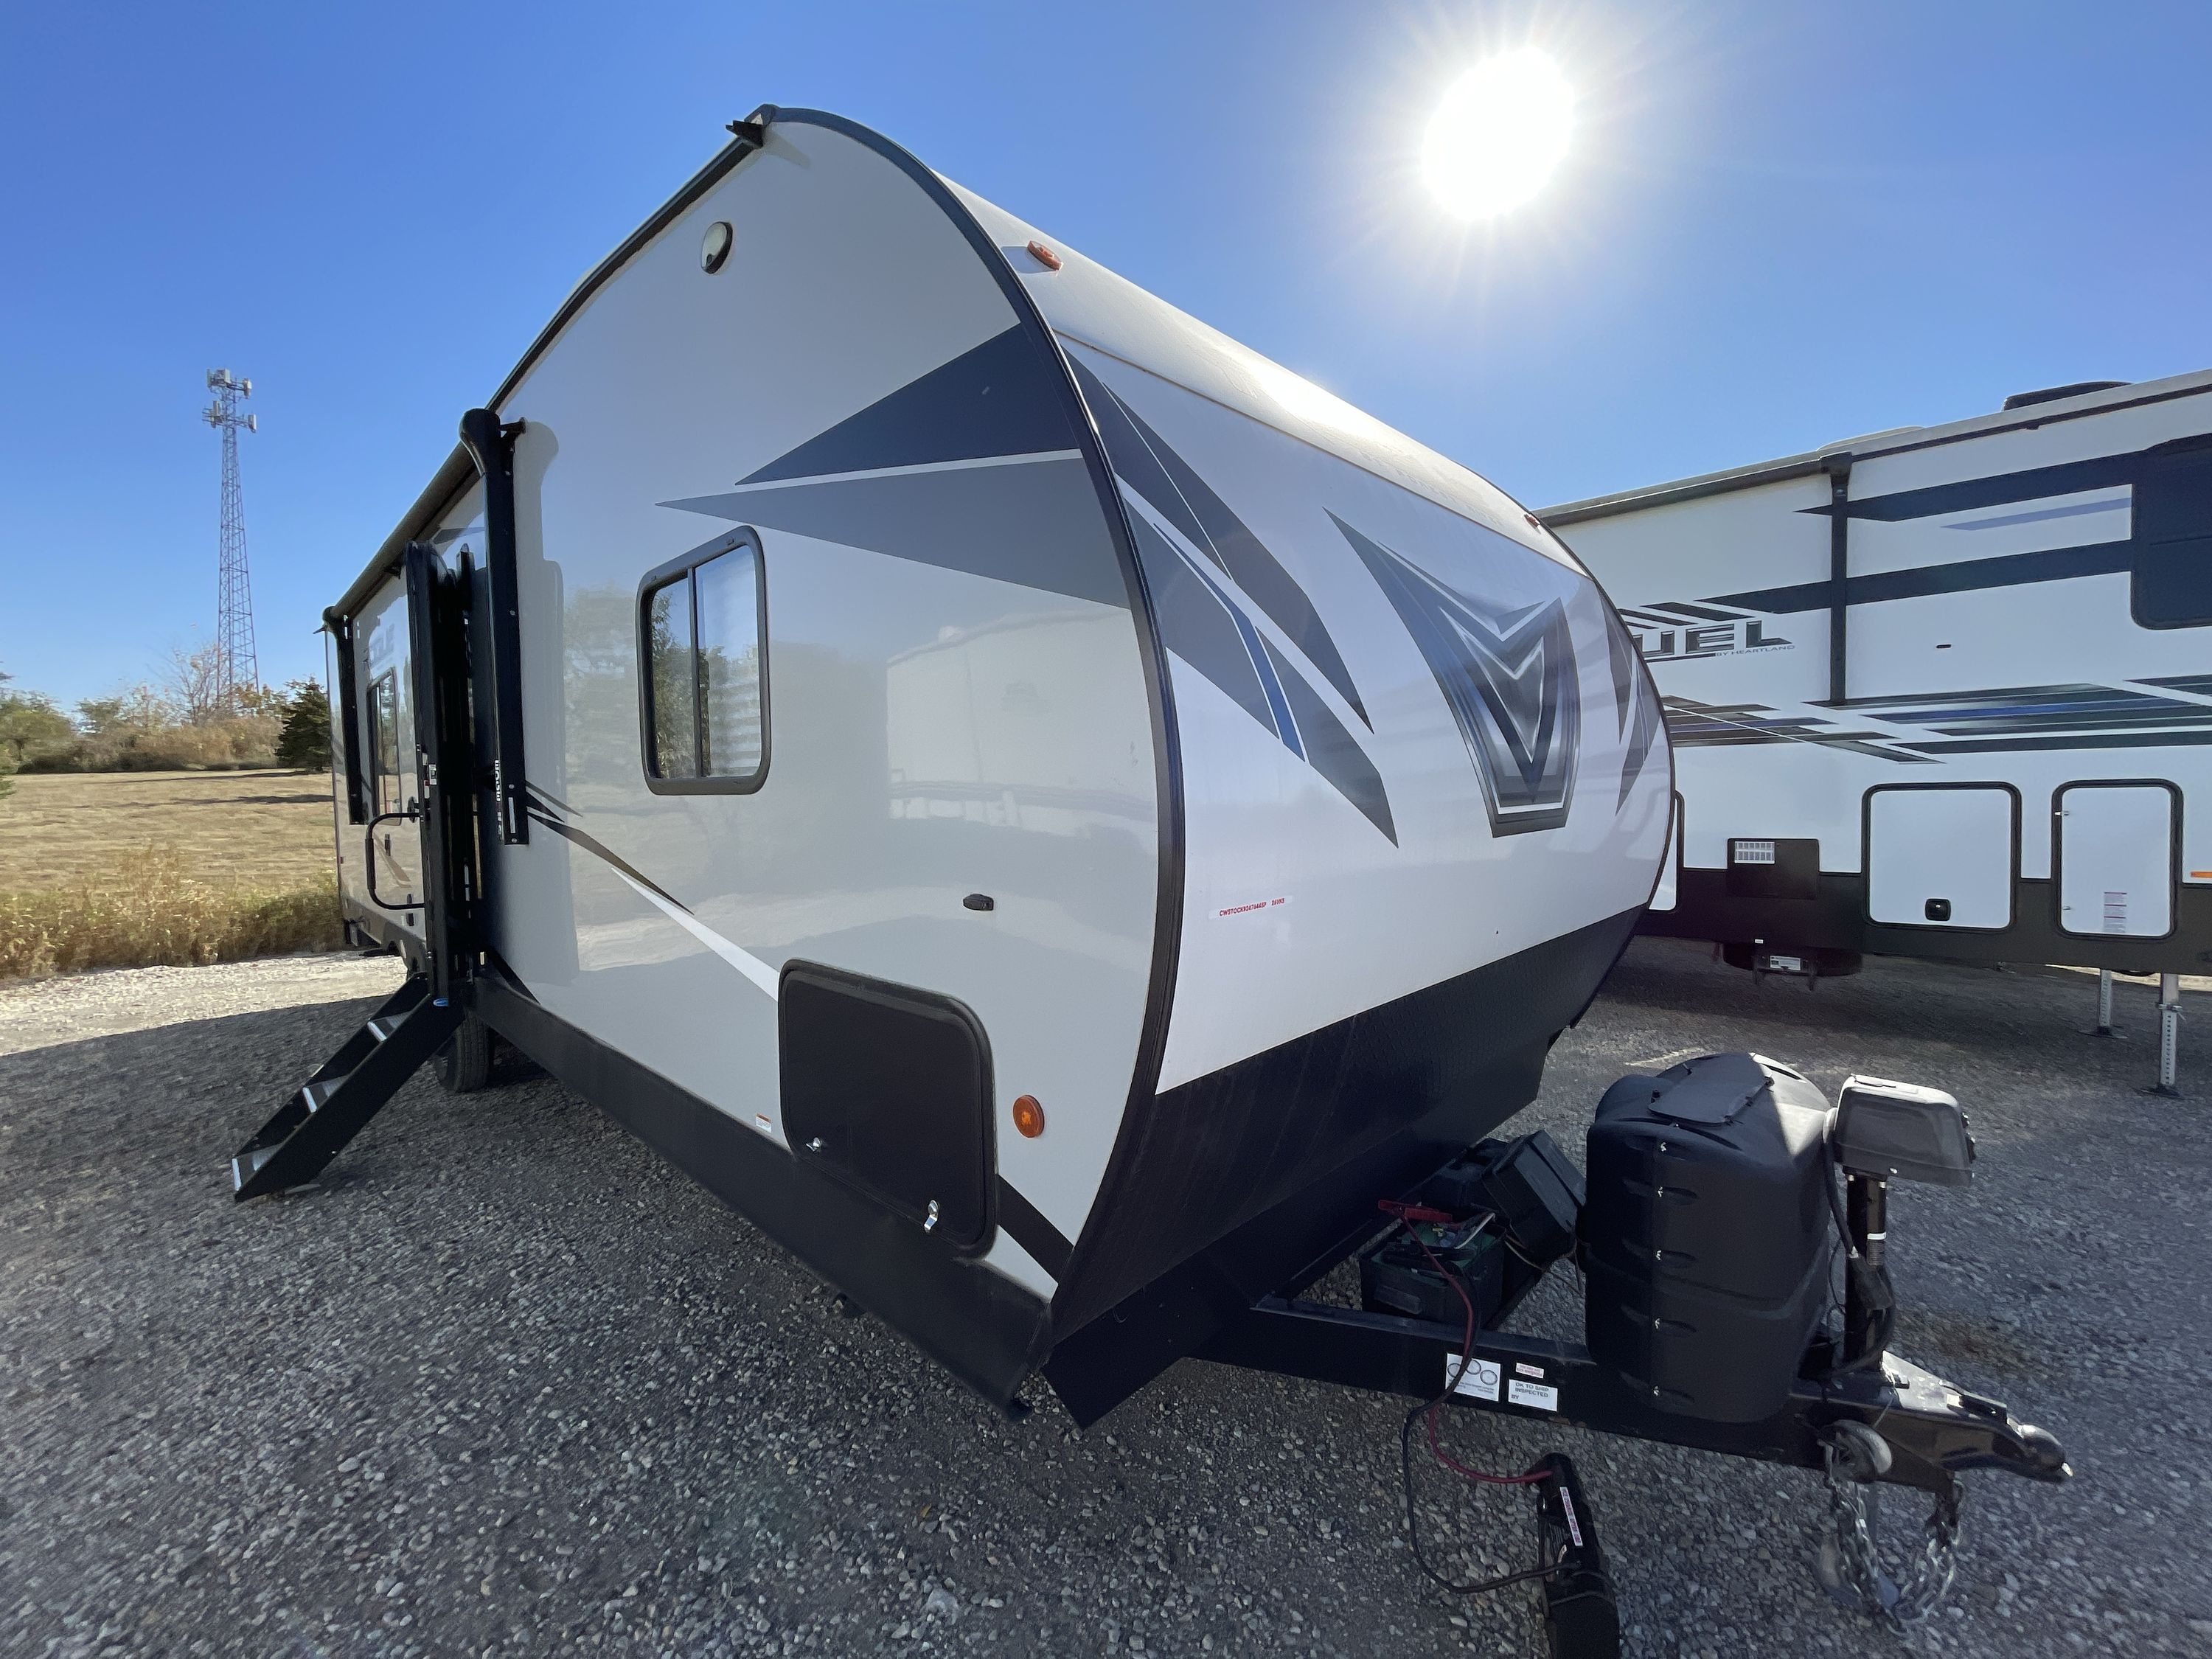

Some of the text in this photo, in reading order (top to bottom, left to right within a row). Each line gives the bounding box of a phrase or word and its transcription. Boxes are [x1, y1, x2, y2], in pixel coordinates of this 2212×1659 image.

[1632, 620, 1792, 658] UEL
[1731, 644, 1795, 655] HEARTLAND
[1514, 1388, 1548, 1398] INSPECTED
